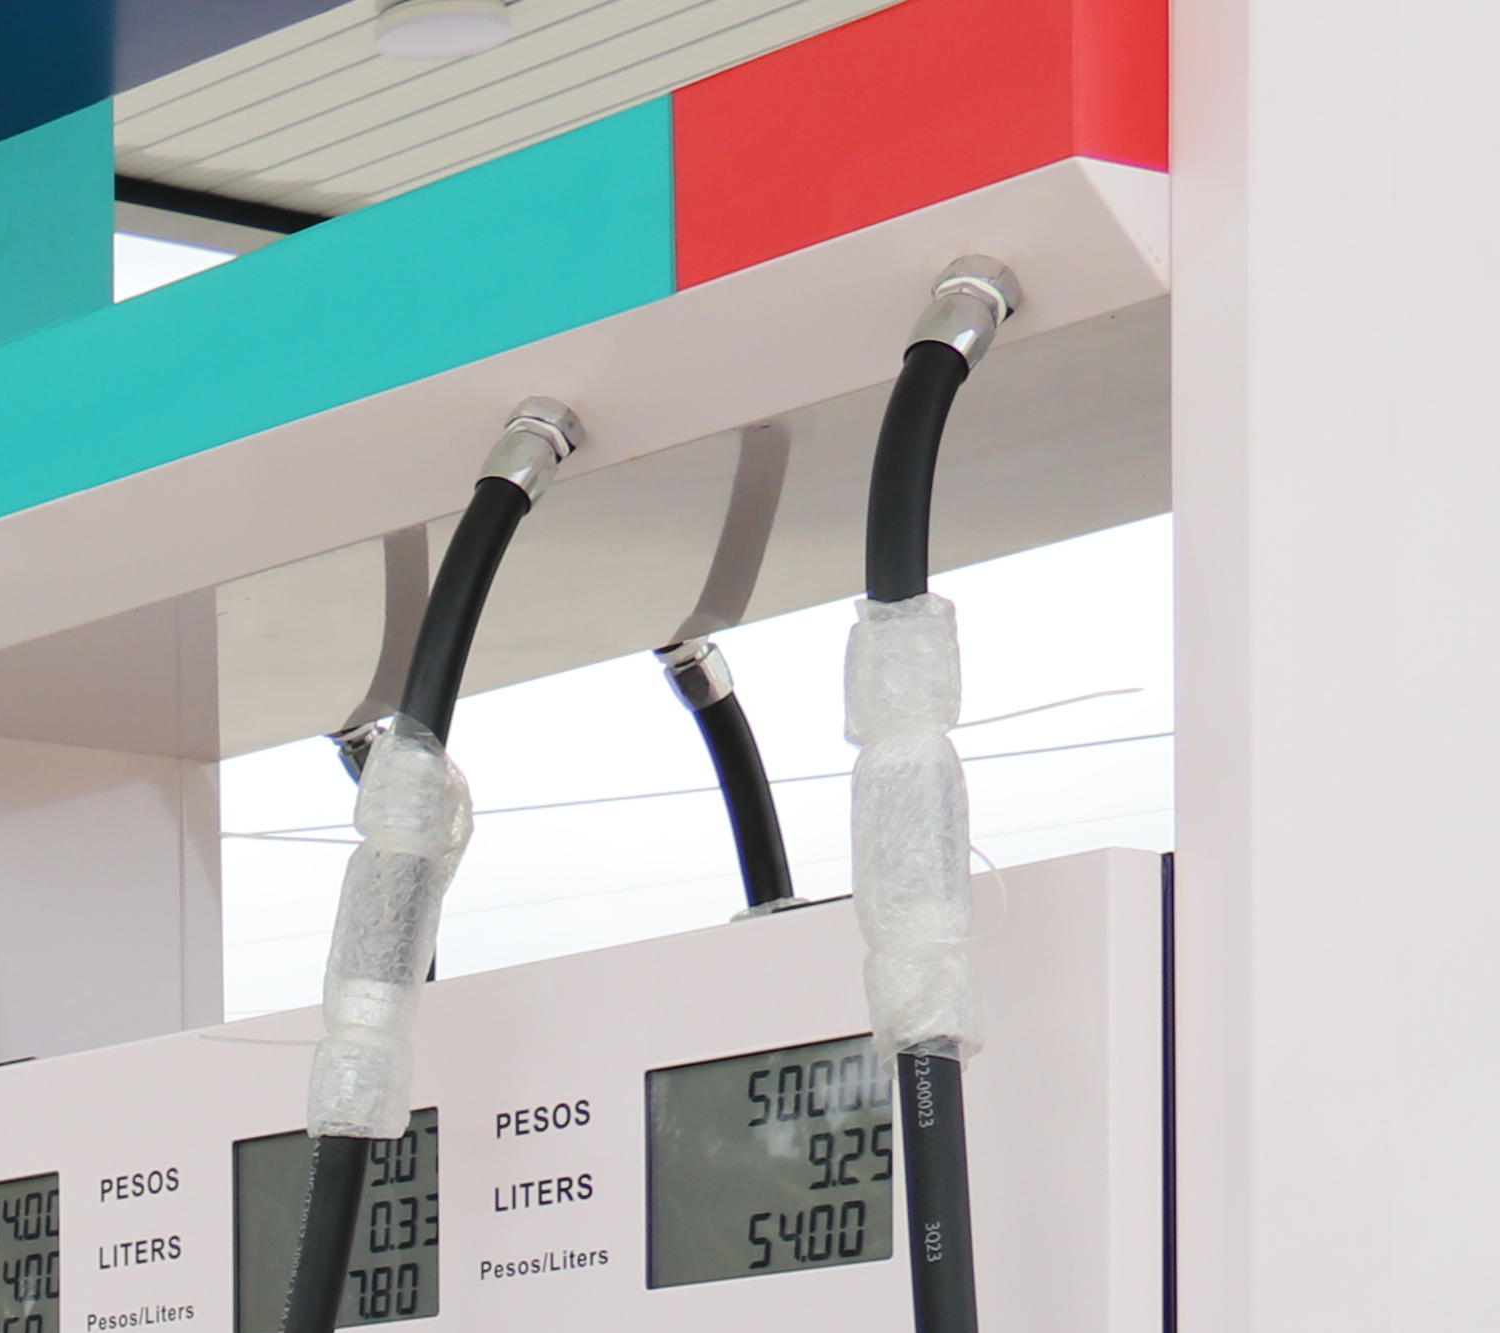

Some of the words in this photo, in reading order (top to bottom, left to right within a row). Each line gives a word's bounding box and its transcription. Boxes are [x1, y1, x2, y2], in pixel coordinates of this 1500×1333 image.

[496, 1099, 590, 1139] PESOS
[809, 1123, 892, 1189] 9.25
[100, 1167, 179, 1202] PESOS
[495, 1173, 593, 1212] LITERS
[99, 1235, 181, 1269] LITERS
[749, 1201, 865, 1269] 54.00
[924, 1221, 943, 1262] 3Q23
[480, 1250, 608, 1280] Pesos/Liters
[87, 1304, 194, 1331] Pesos/Liters
